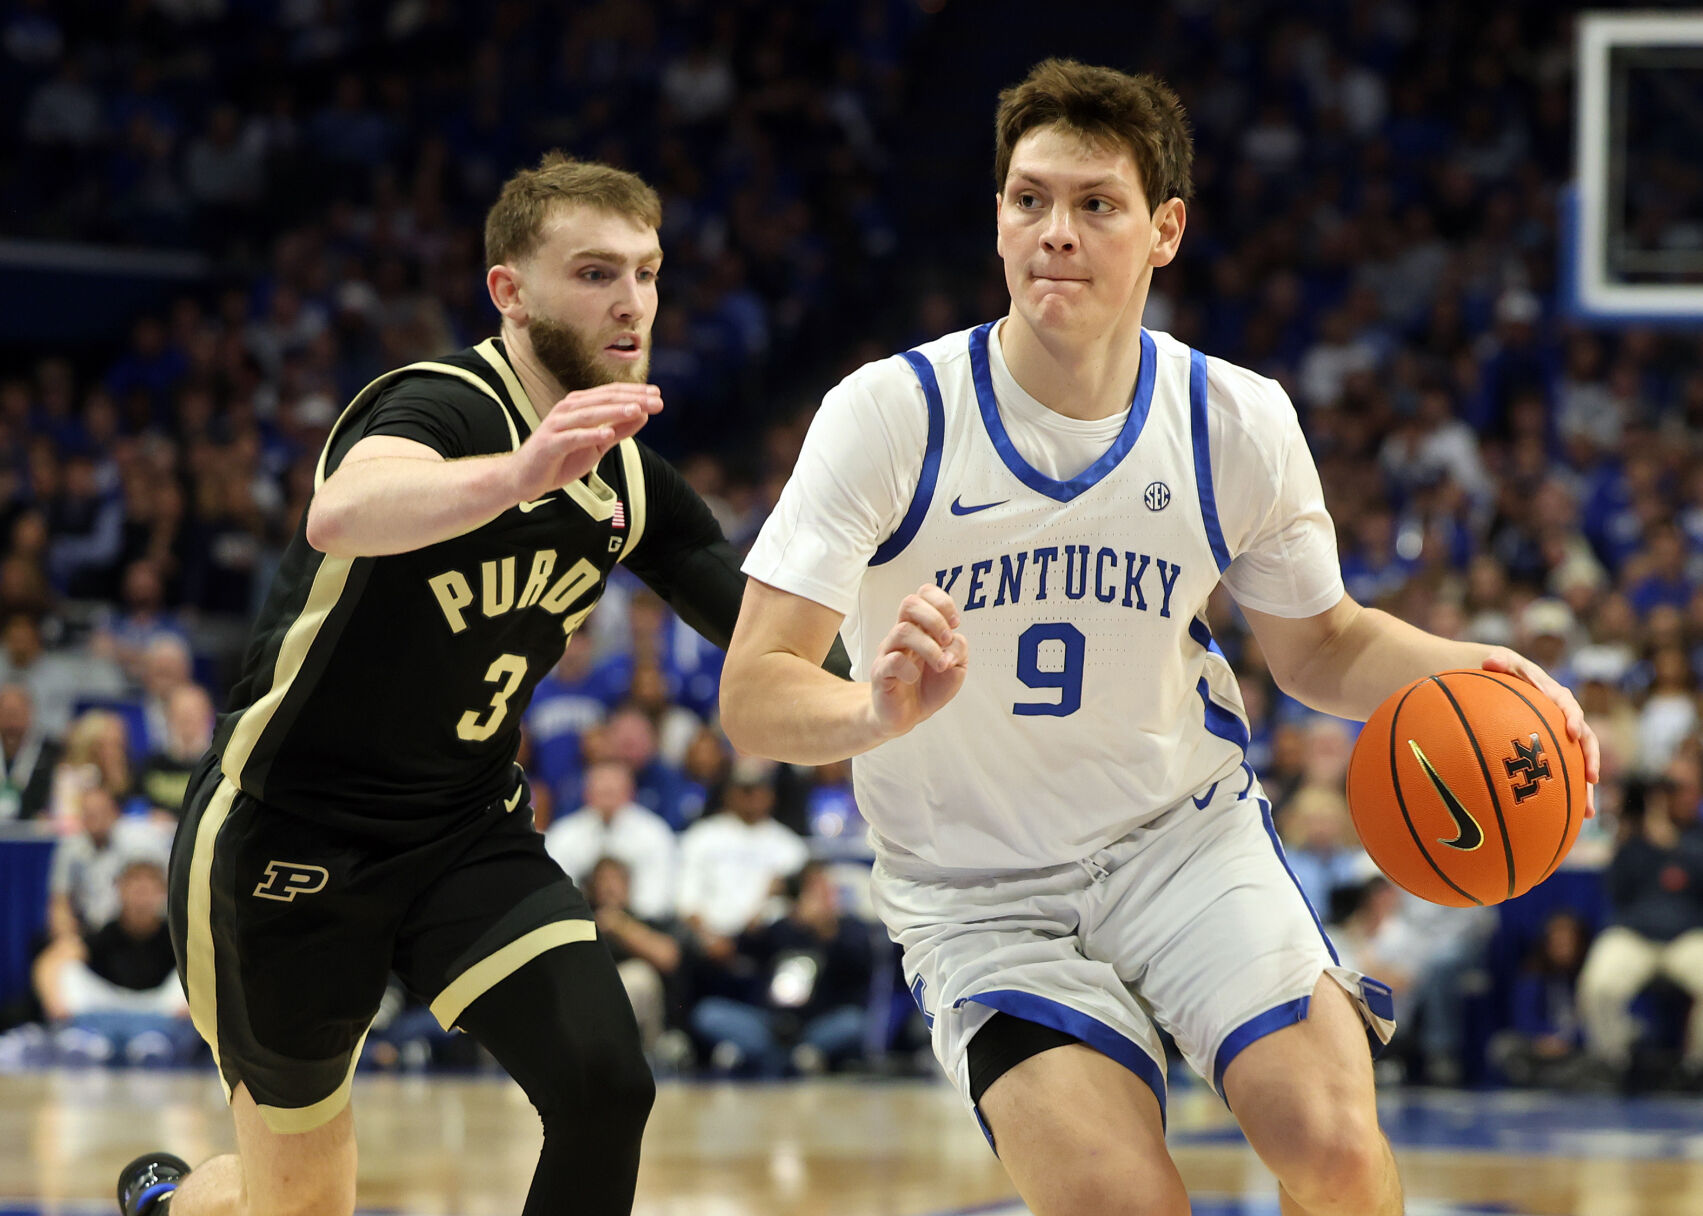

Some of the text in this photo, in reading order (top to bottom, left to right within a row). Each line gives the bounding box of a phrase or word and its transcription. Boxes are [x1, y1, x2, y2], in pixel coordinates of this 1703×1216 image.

[1144, 481, 1171, 511] SEC
[427, 549, 603, 648] PURD
[456, 653, 529, 742] 3
[1012, 622, 1086, 717] 9
[252, 860, 330, 902] P
